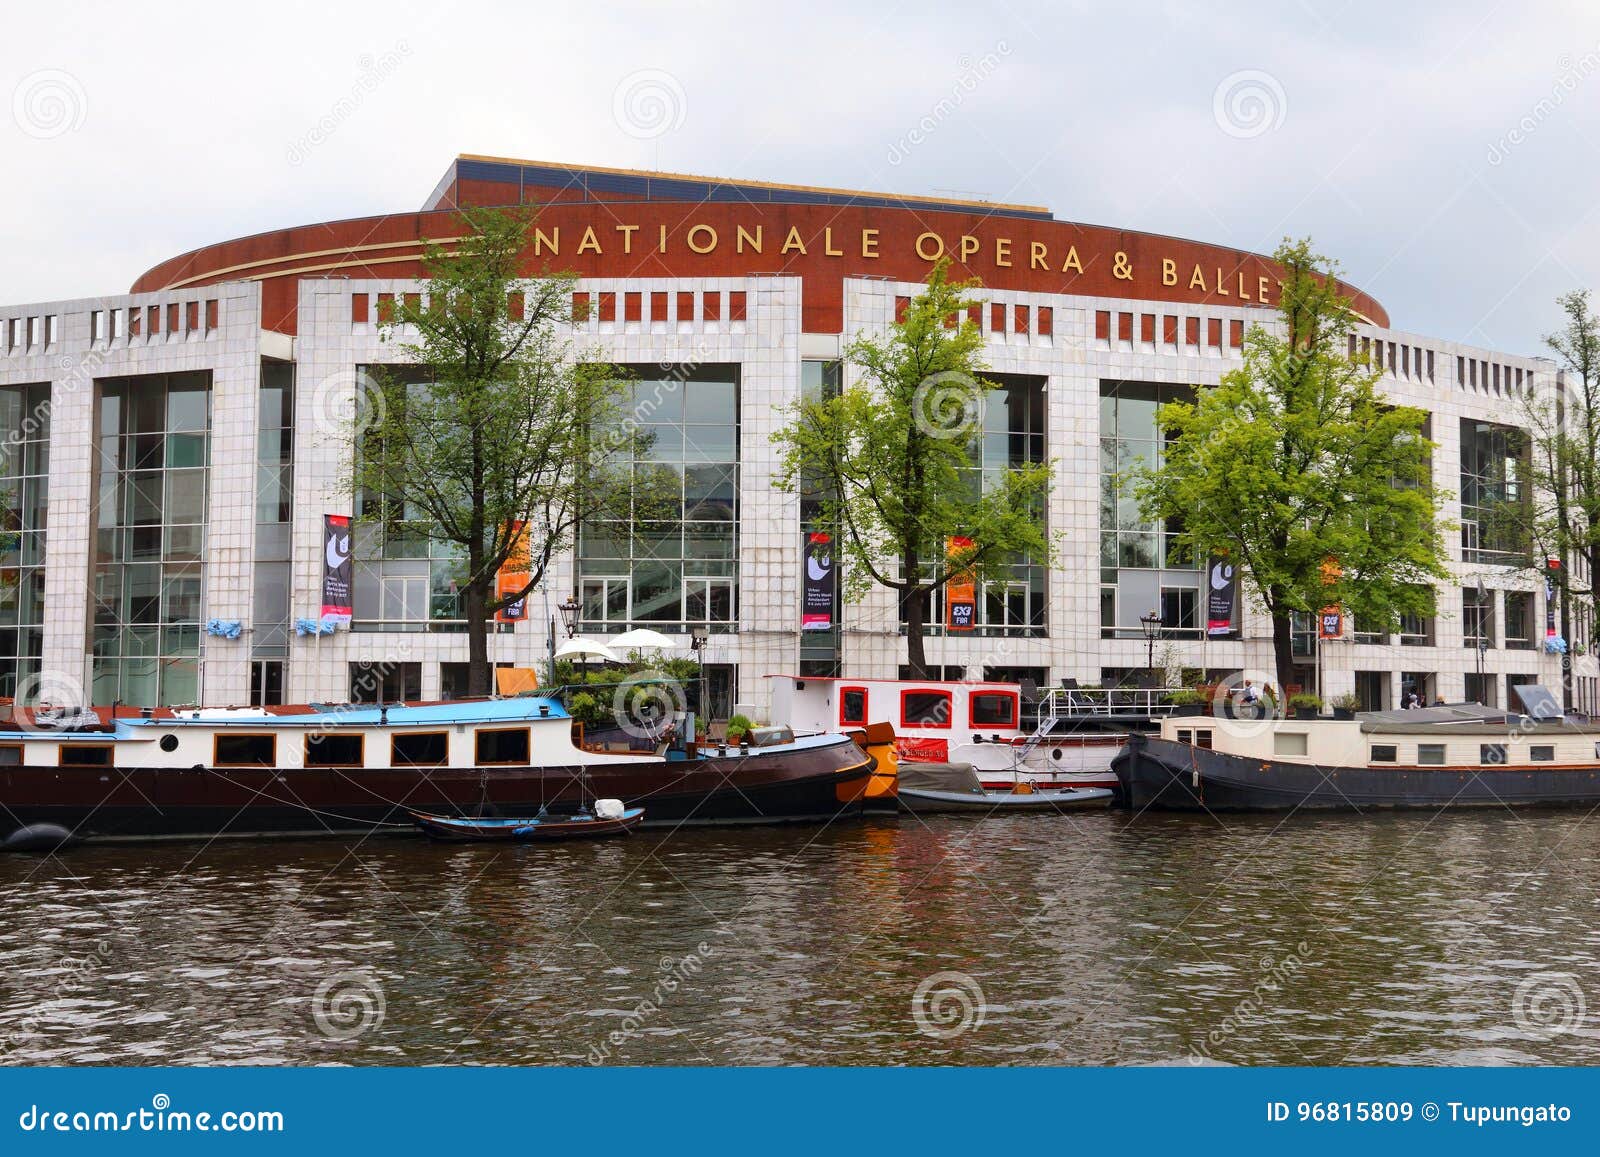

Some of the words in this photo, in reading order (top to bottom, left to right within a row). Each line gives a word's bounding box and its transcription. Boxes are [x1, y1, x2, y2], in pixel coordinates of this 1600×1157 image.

[535, 224, 880, 259] NATIONALE
[915, 231, 1084, 275] OPERA
[1112, 251, 1134, 281] &
[1162, 257, 1285, 304] BALLE
